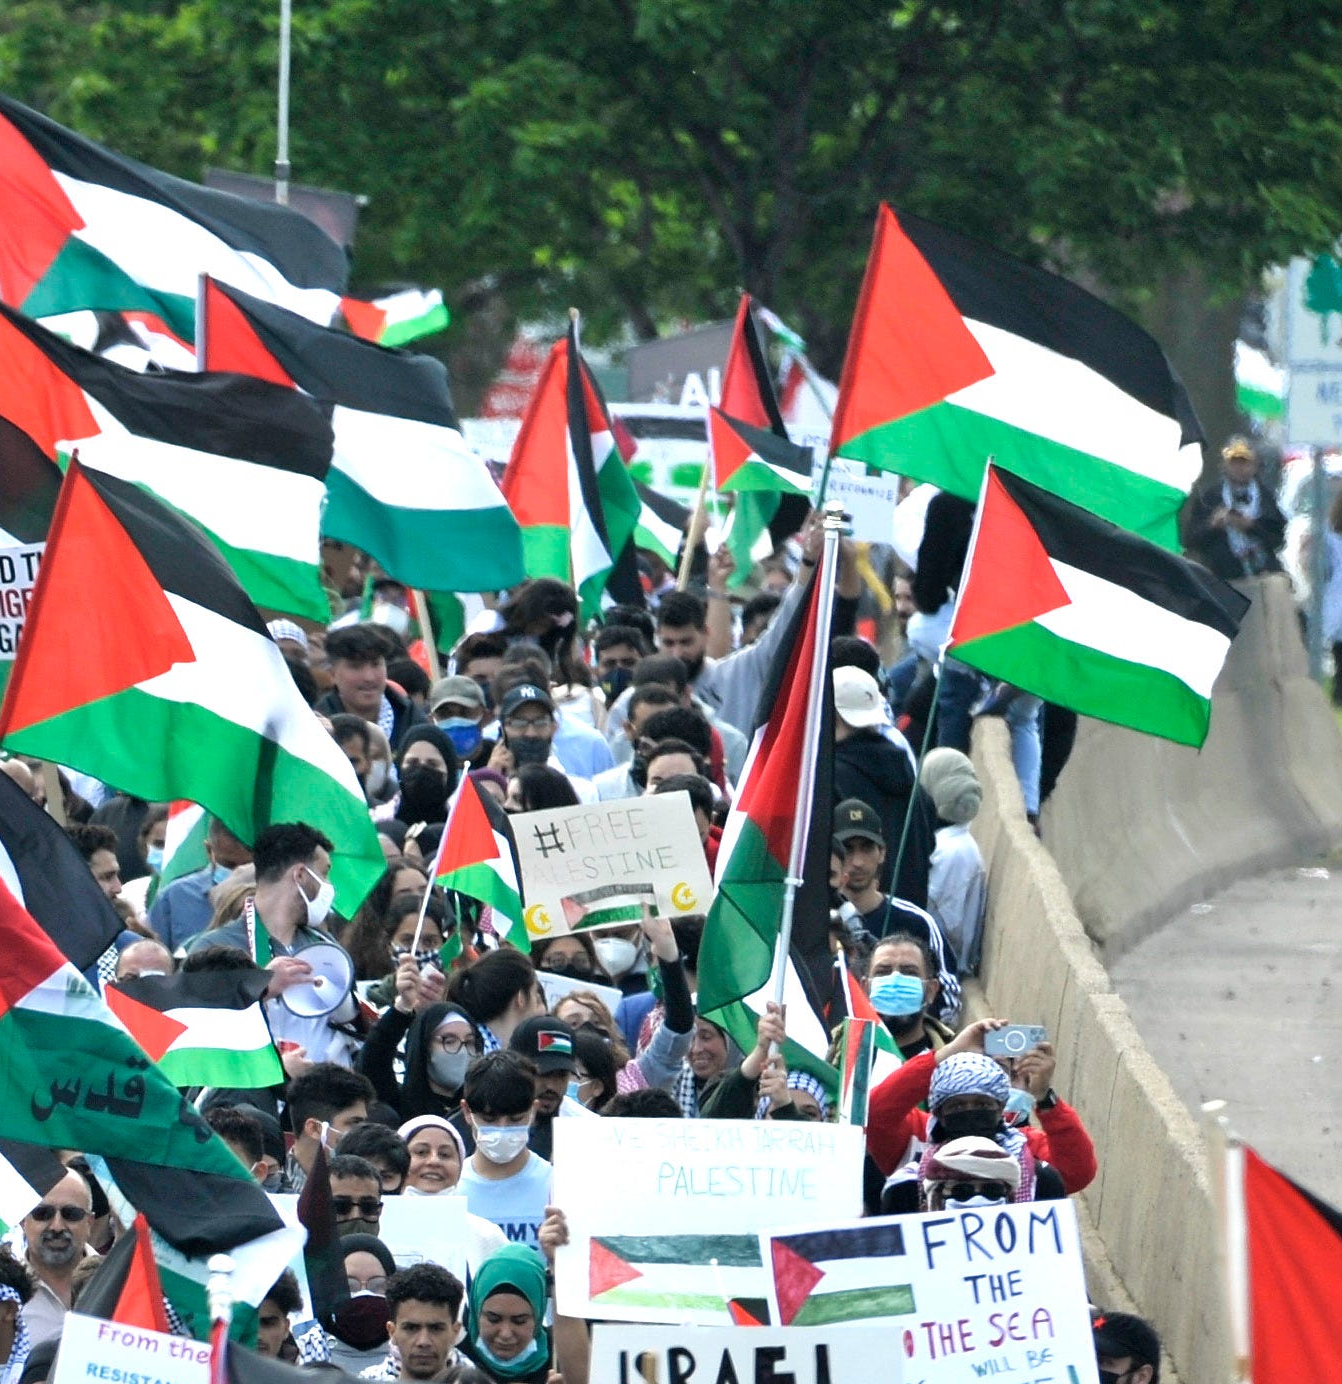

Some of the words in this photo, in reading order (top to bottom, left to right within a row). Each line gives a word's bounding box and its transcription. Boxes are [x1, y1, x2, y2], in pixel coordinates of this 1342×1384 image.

[922, 1206, 1064, 1270] FROM
[964, 1270, 1024, 1304] THE
[98, 1323, 159, 1353] From
[167, 1337, 210, 1365] the
[920, 1317, 976, 1360] THE
[990, 1307, 1055, 1348] SEA
[971, 1360, 1012, 1378] WILL
[1026, 1347, 1055, 1365] BE
